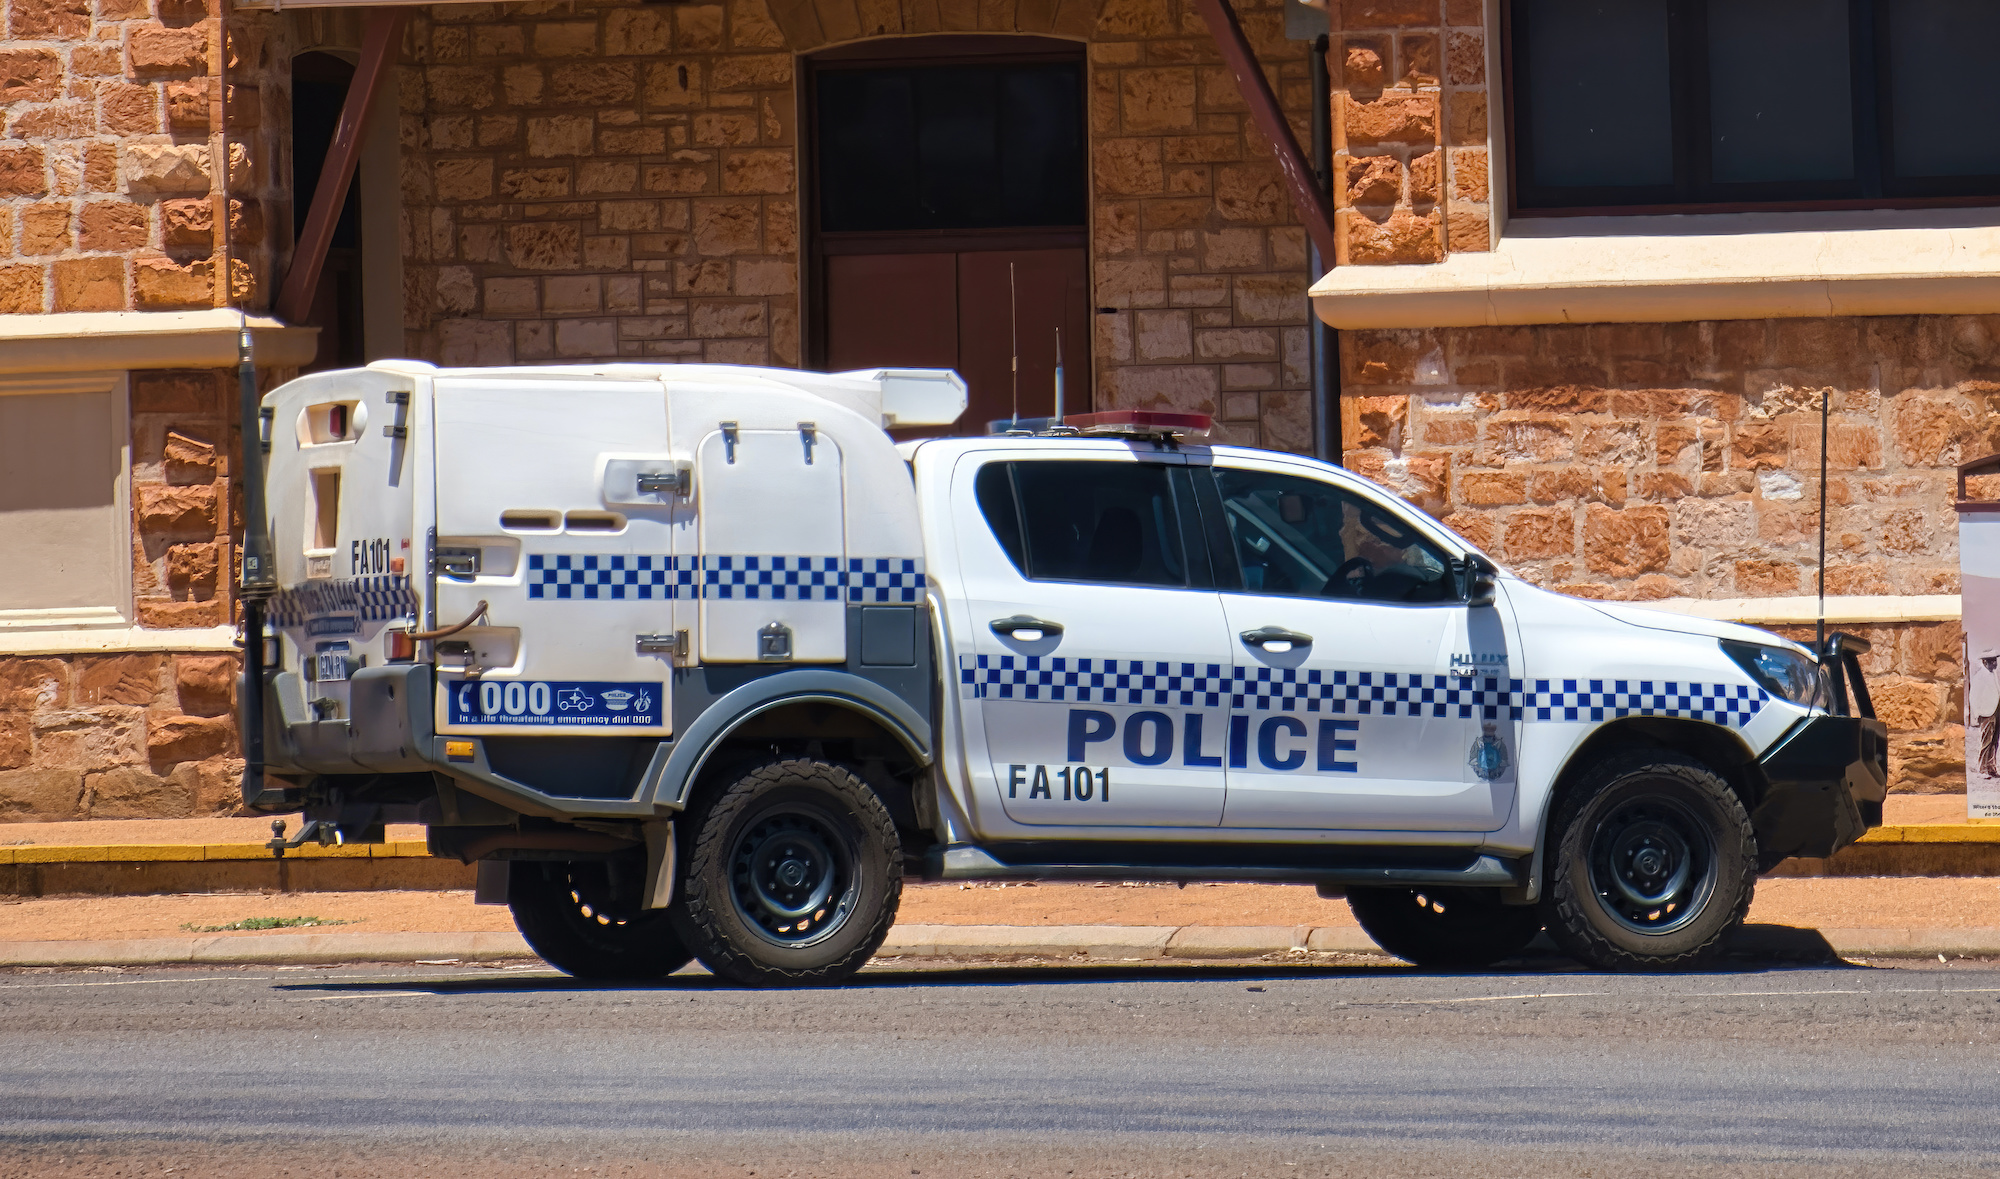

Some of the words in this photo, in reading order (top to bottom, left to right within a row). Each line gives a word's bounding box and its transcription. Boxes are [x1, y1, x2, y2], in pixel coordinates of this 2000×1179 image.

[352, 538, 390, 575] FA101
[480, 682, 551, 715] 000
[1067, 709, 1360, 773] POLICE
